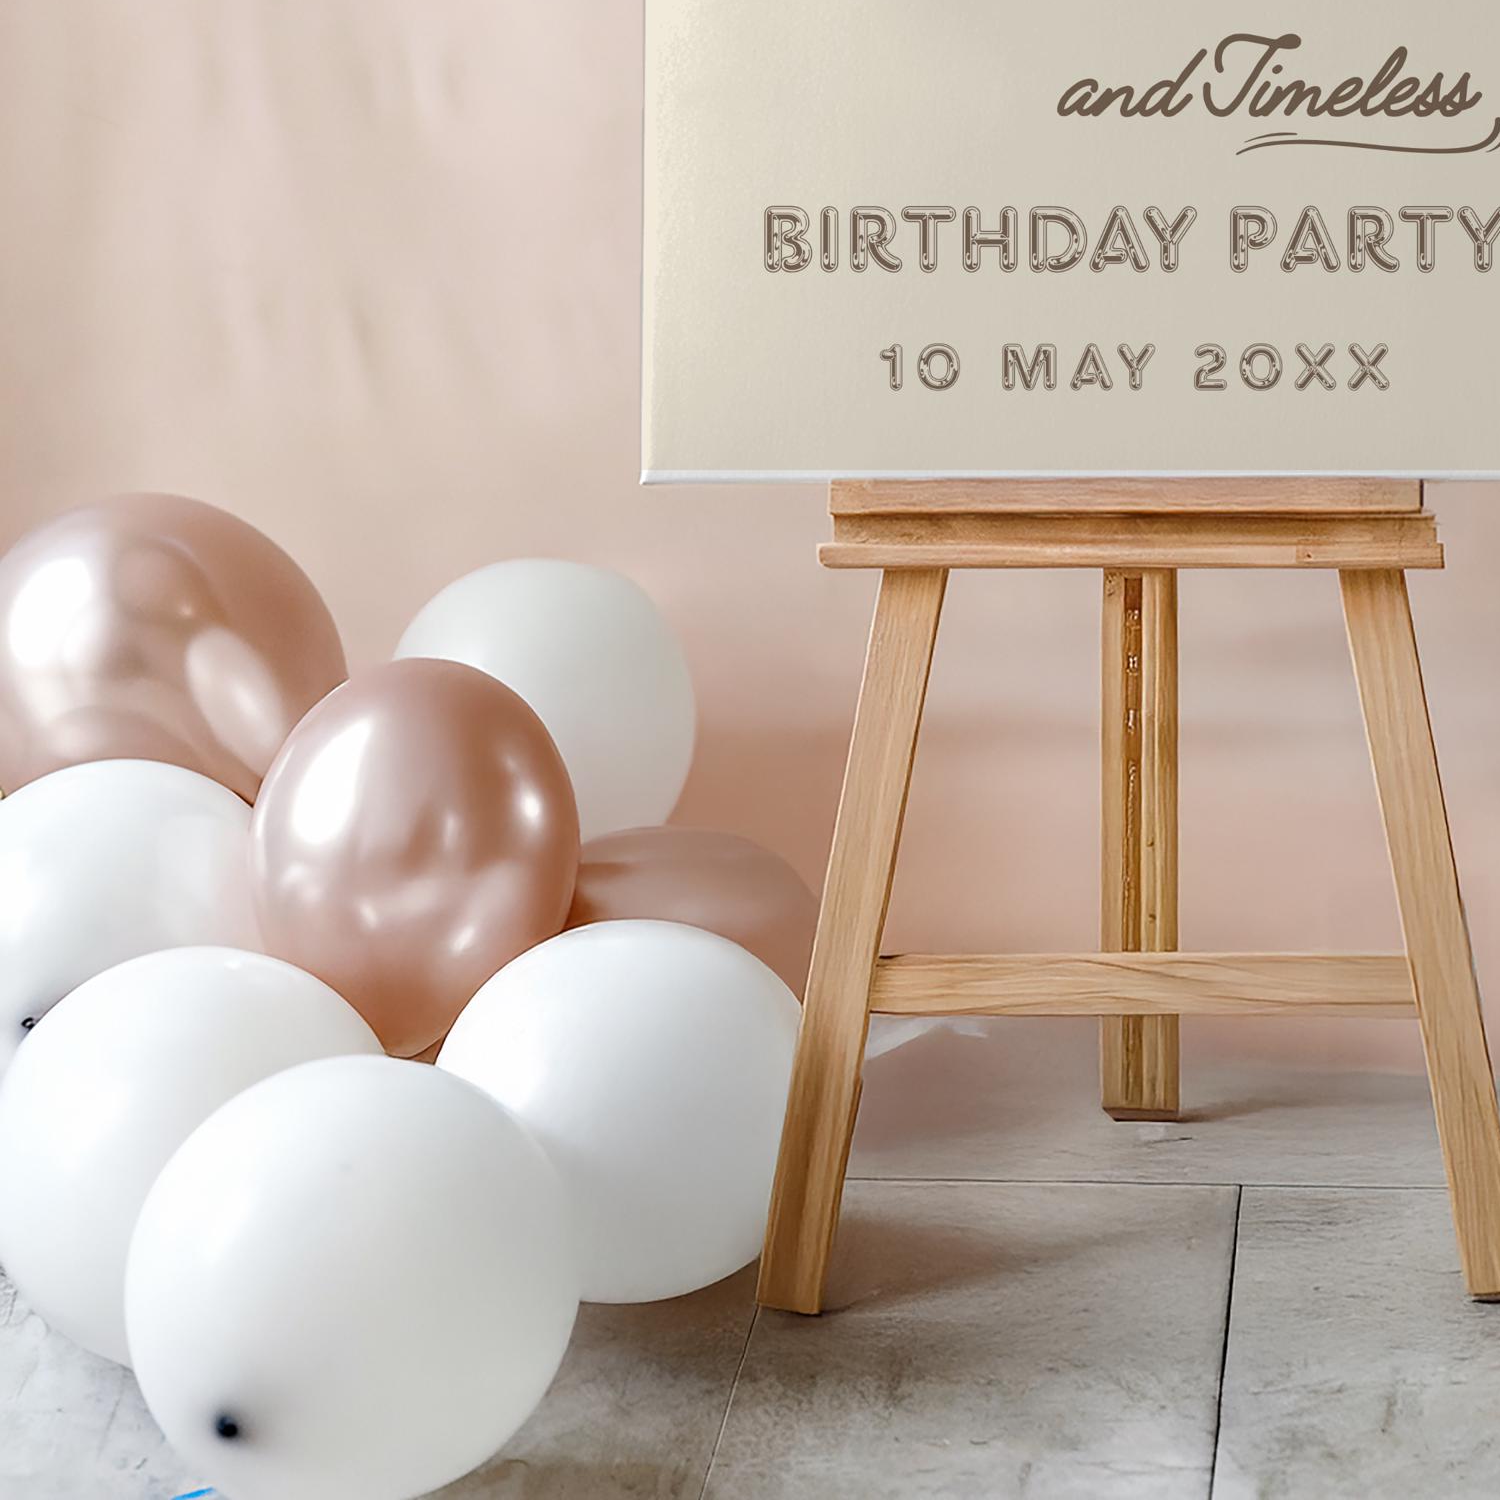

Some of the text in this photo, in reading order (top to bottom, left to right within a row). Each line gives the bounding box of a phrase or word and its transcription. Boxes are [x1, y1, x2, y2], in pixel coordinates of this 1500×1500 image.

[1057, 33, 1483, 118] and Timeless
[764, 205, 1198, 274] BIRTHDAY
[880, 343, 1391, 392] 10 MAY 20XX
